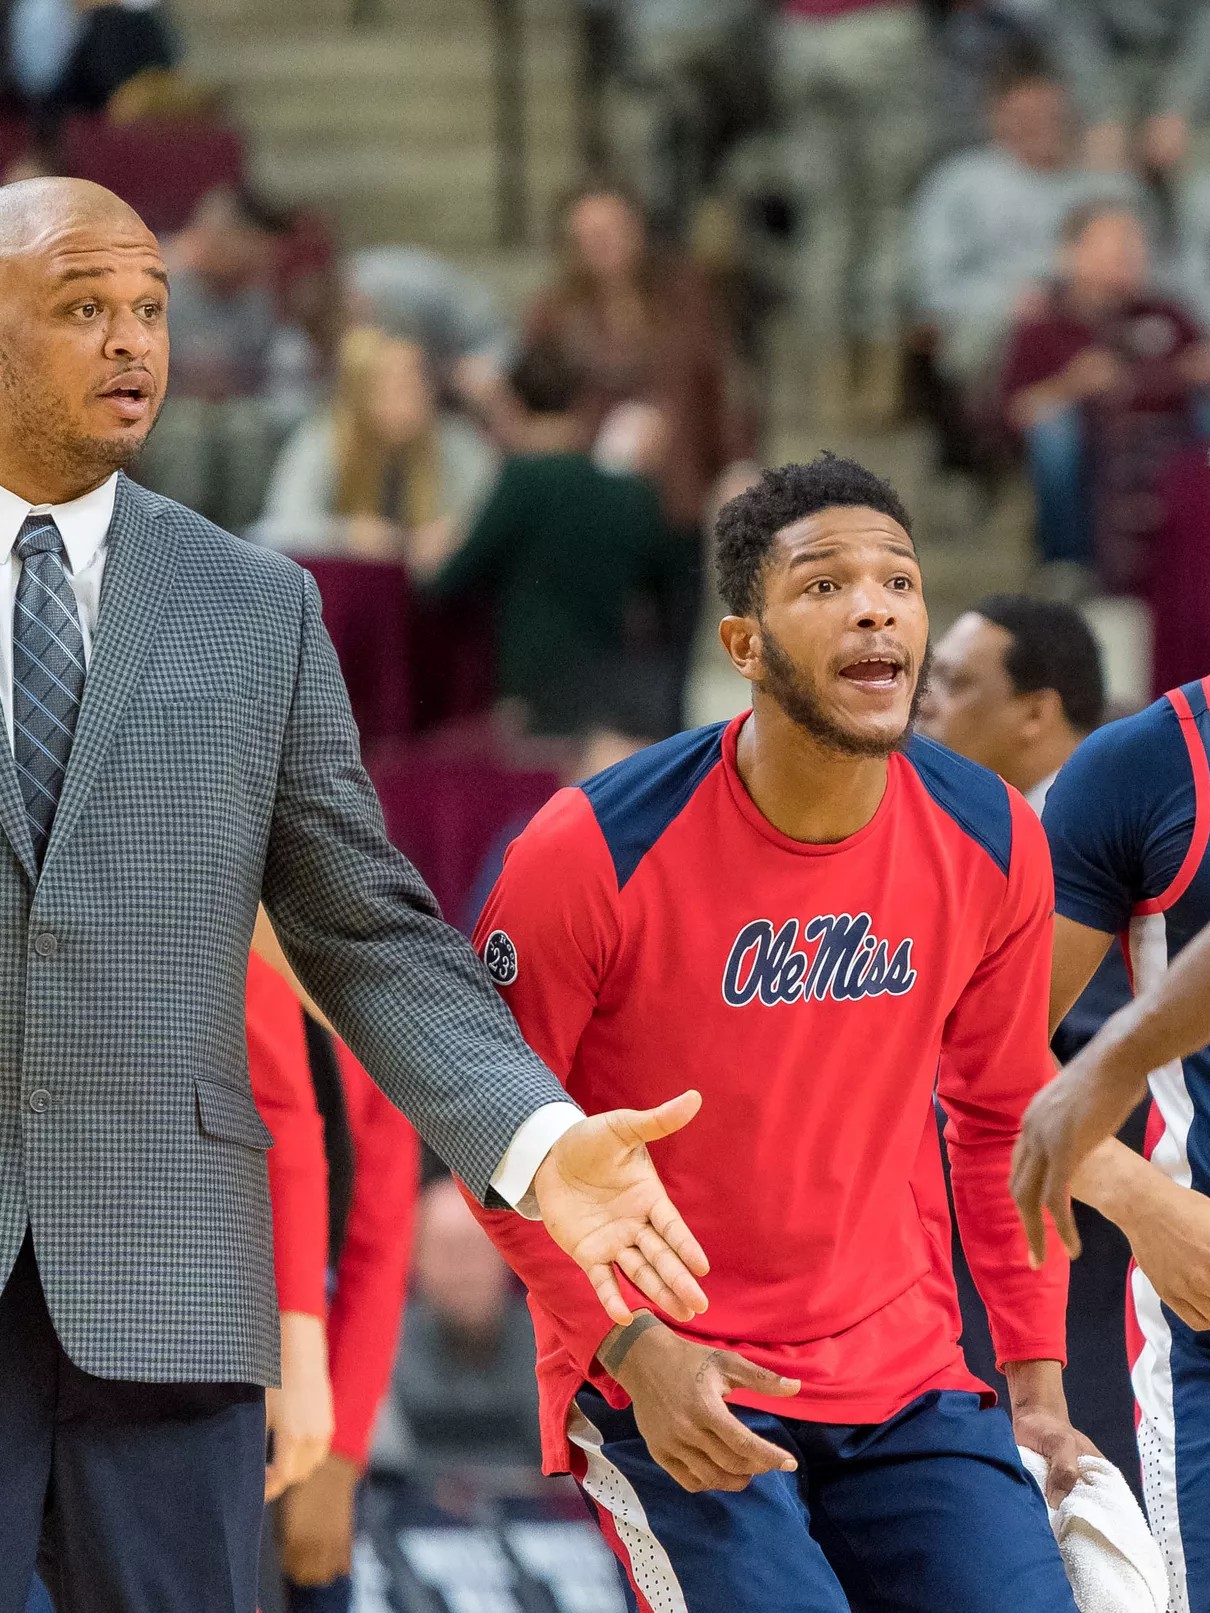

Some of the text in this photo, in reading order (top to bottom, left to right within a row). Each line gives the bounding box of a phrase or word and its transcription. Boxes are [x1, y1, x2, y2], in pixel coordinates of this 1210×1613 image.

[488, 947, 510, 979] 23
[721, 912, 918, 1008] Ole Miss
